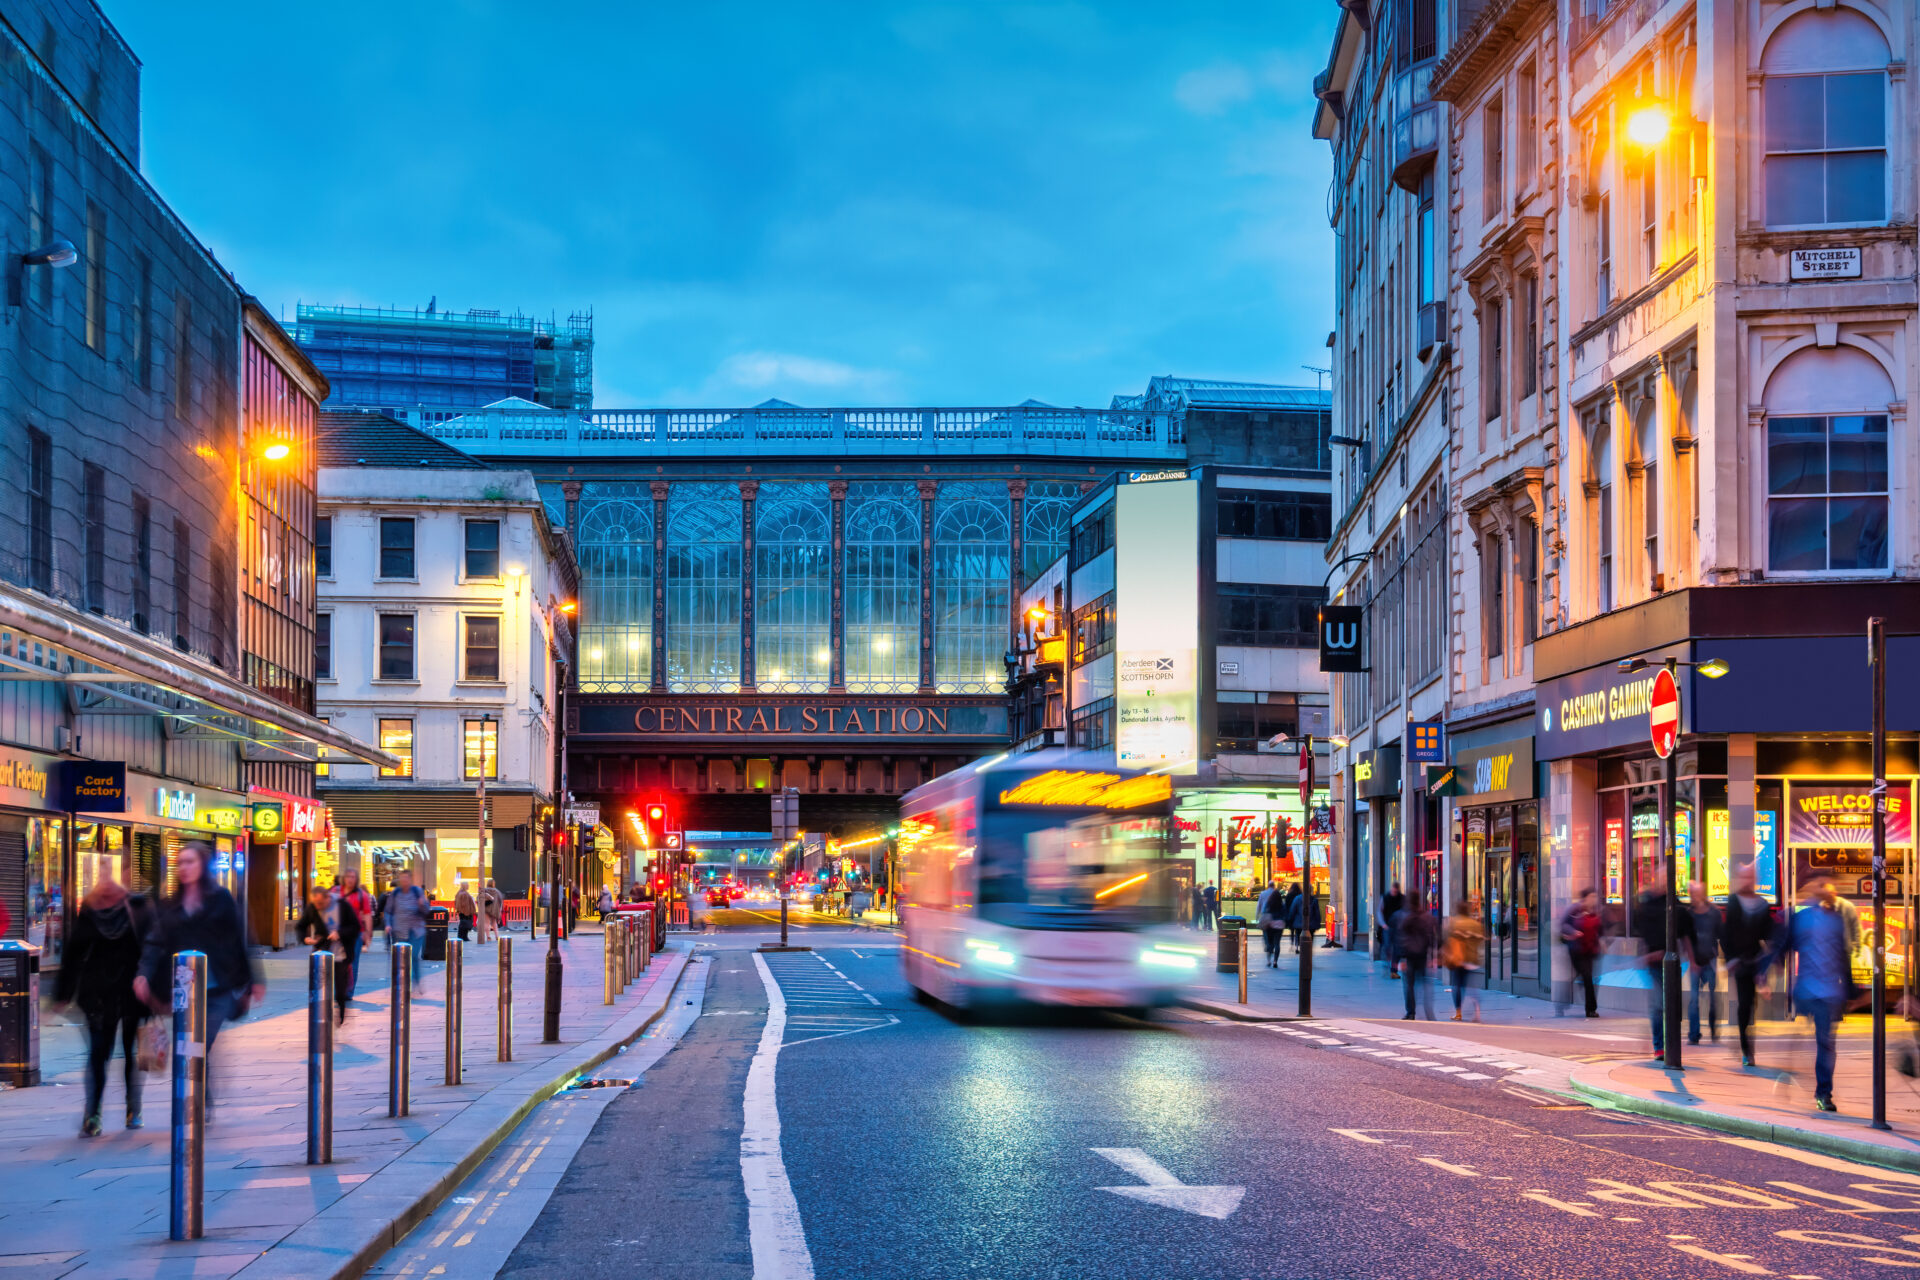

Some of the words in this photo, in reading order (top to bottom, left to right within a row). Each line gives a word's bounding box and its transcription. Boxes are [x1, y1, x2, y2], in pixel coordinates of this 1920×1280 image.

[1795, 251, 1856, 261] MITCHELL
[1803, 262, 1849, 271] STREET
[1121, 659, 1155, 668] Aberdeen
[1121, 673, 1154, 681] SCOTTISH
[1155, 672, 1174, 680] OPEN
[1561, 690, 1606, 732] CASHINO
[1609, 677, 1655, 721] GAMING
[1121, 708, 1131, 716] July
[634, 706, 792, 733] CENTRAL
[801, 706, 950, 733] STATION
[1164, 715, 1186, 723] Ayrshire
[1473, 752, 1514, 794] SUBWAY
[16, 761, 47, 799] Factory
[84, 775, 113, 786] Card
[1430, 768, 1455, 795] SUBWAY
[76, 786, 121, 798] Factory
[159, 788, 196, 821] Poundland
[1799, 794, 1902, 813] WELCOE
